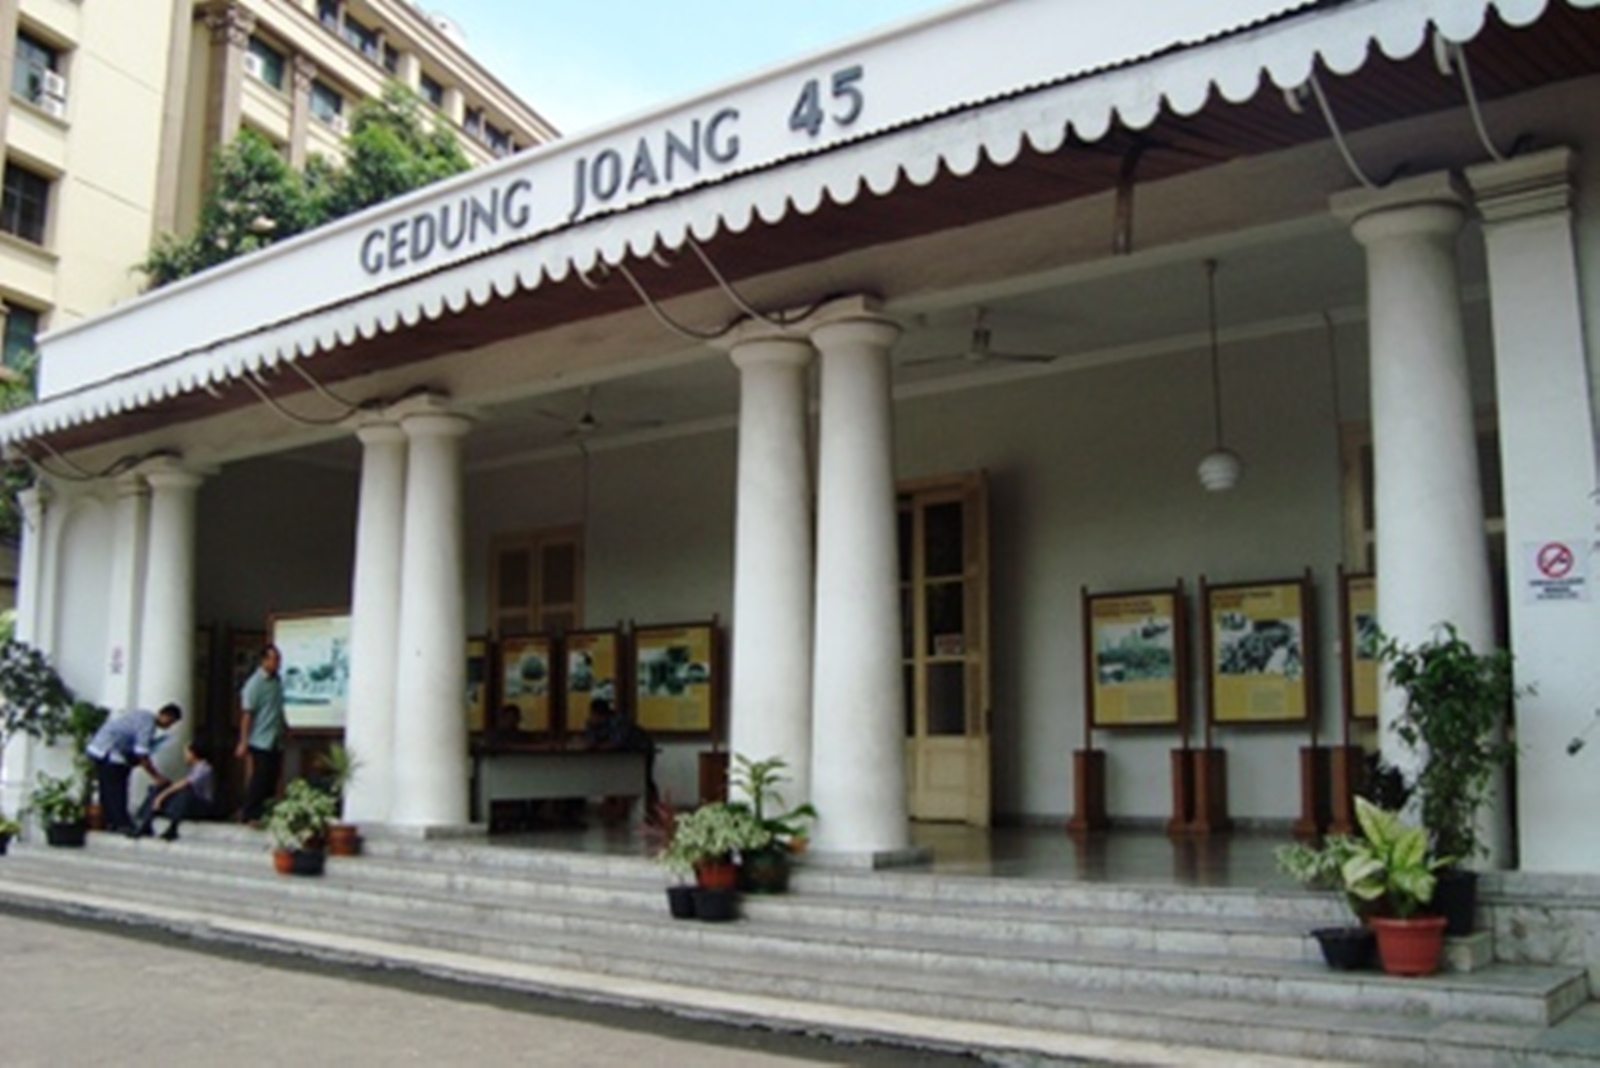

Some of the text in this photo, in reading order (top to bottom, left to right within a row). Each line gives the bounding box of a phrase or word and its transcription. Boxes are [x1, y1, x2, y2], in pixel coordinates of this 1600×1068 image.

[360, 64, 865, 275] GEDUNG JOANG 45
